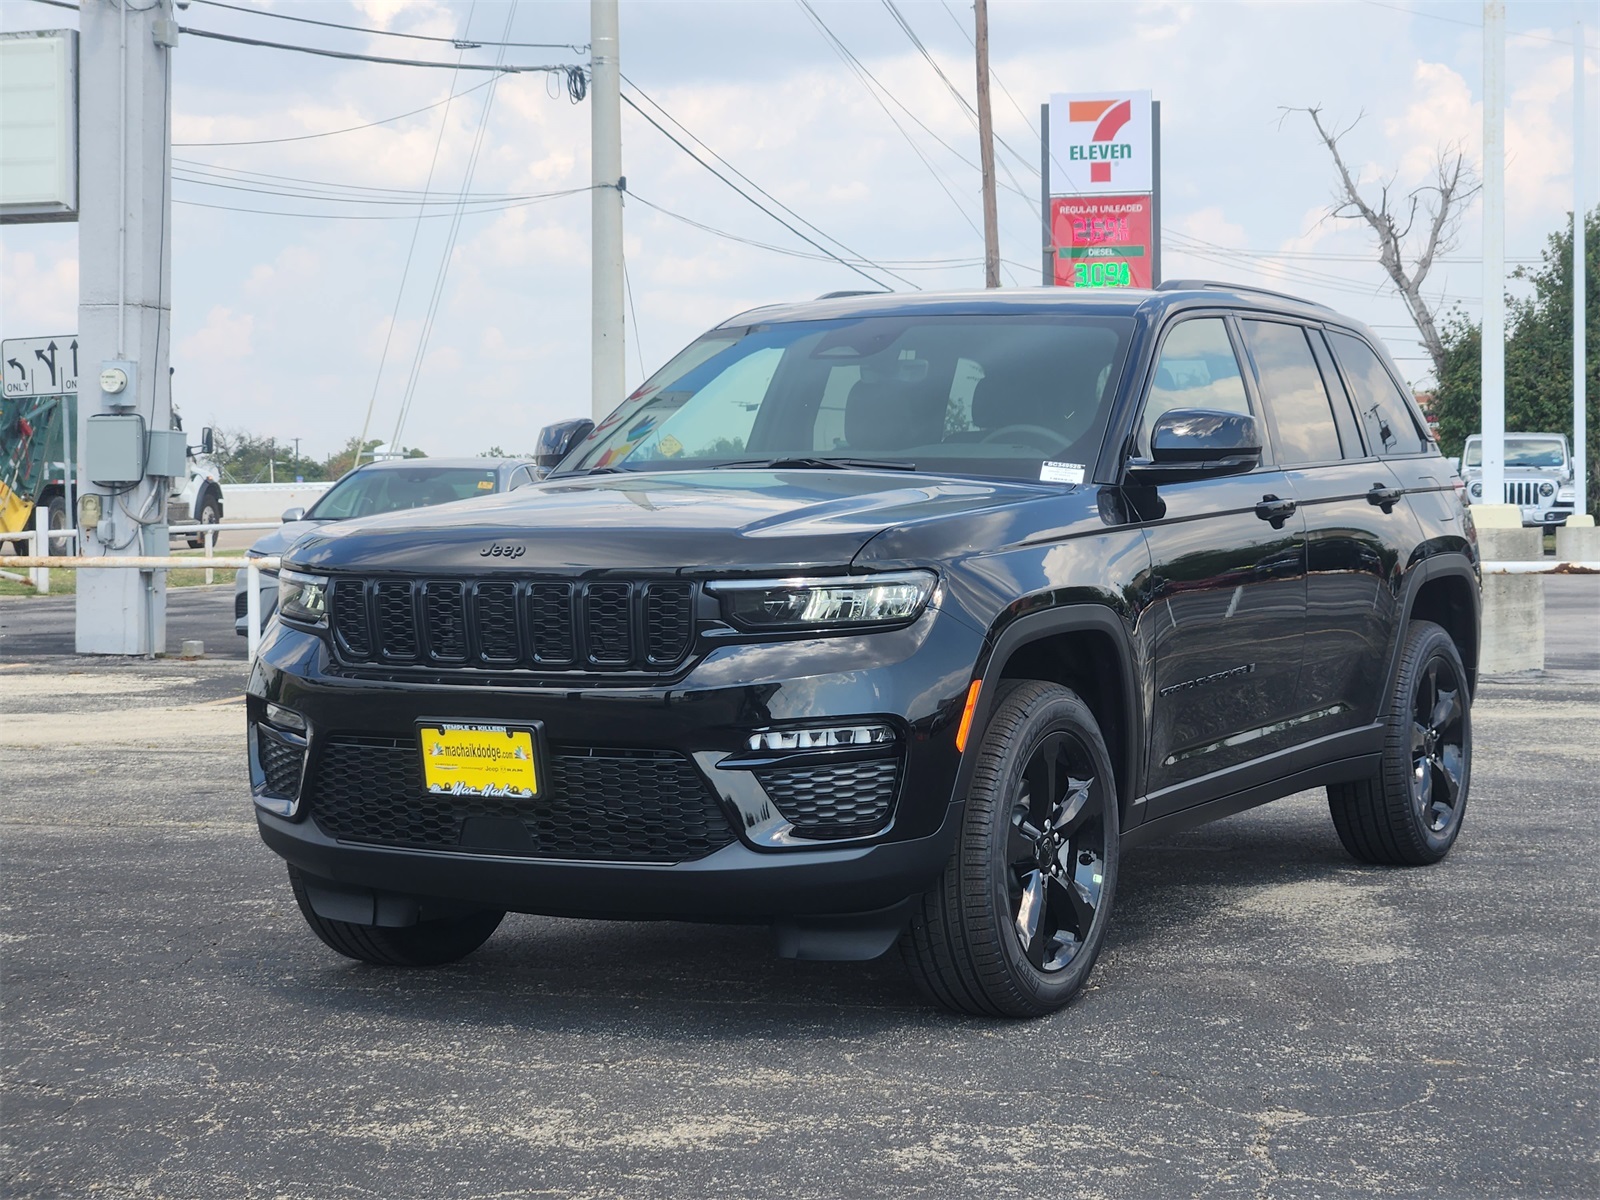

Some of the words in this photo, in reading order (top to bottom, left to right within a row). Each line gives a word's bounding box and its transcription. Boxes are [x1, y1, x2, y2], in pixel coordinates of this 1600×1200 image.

[1069, 99, 1131, 183] 7
[1060, 205, 1098, 215] REGULAR
[1100, 204, 1142, 213] UNLEADED
[1088, 248, 1115, 257] DIESEL
[7, 382, 29, 393] ONLY
[480, 542, 526, 559] Jeep
[477, 725, 507, 733] KILLEEN
[445, 743, 513, 762] machaikdodge.com
[451, 781, 478, 797] Mac
[481, 782, 512, 798] Haik
